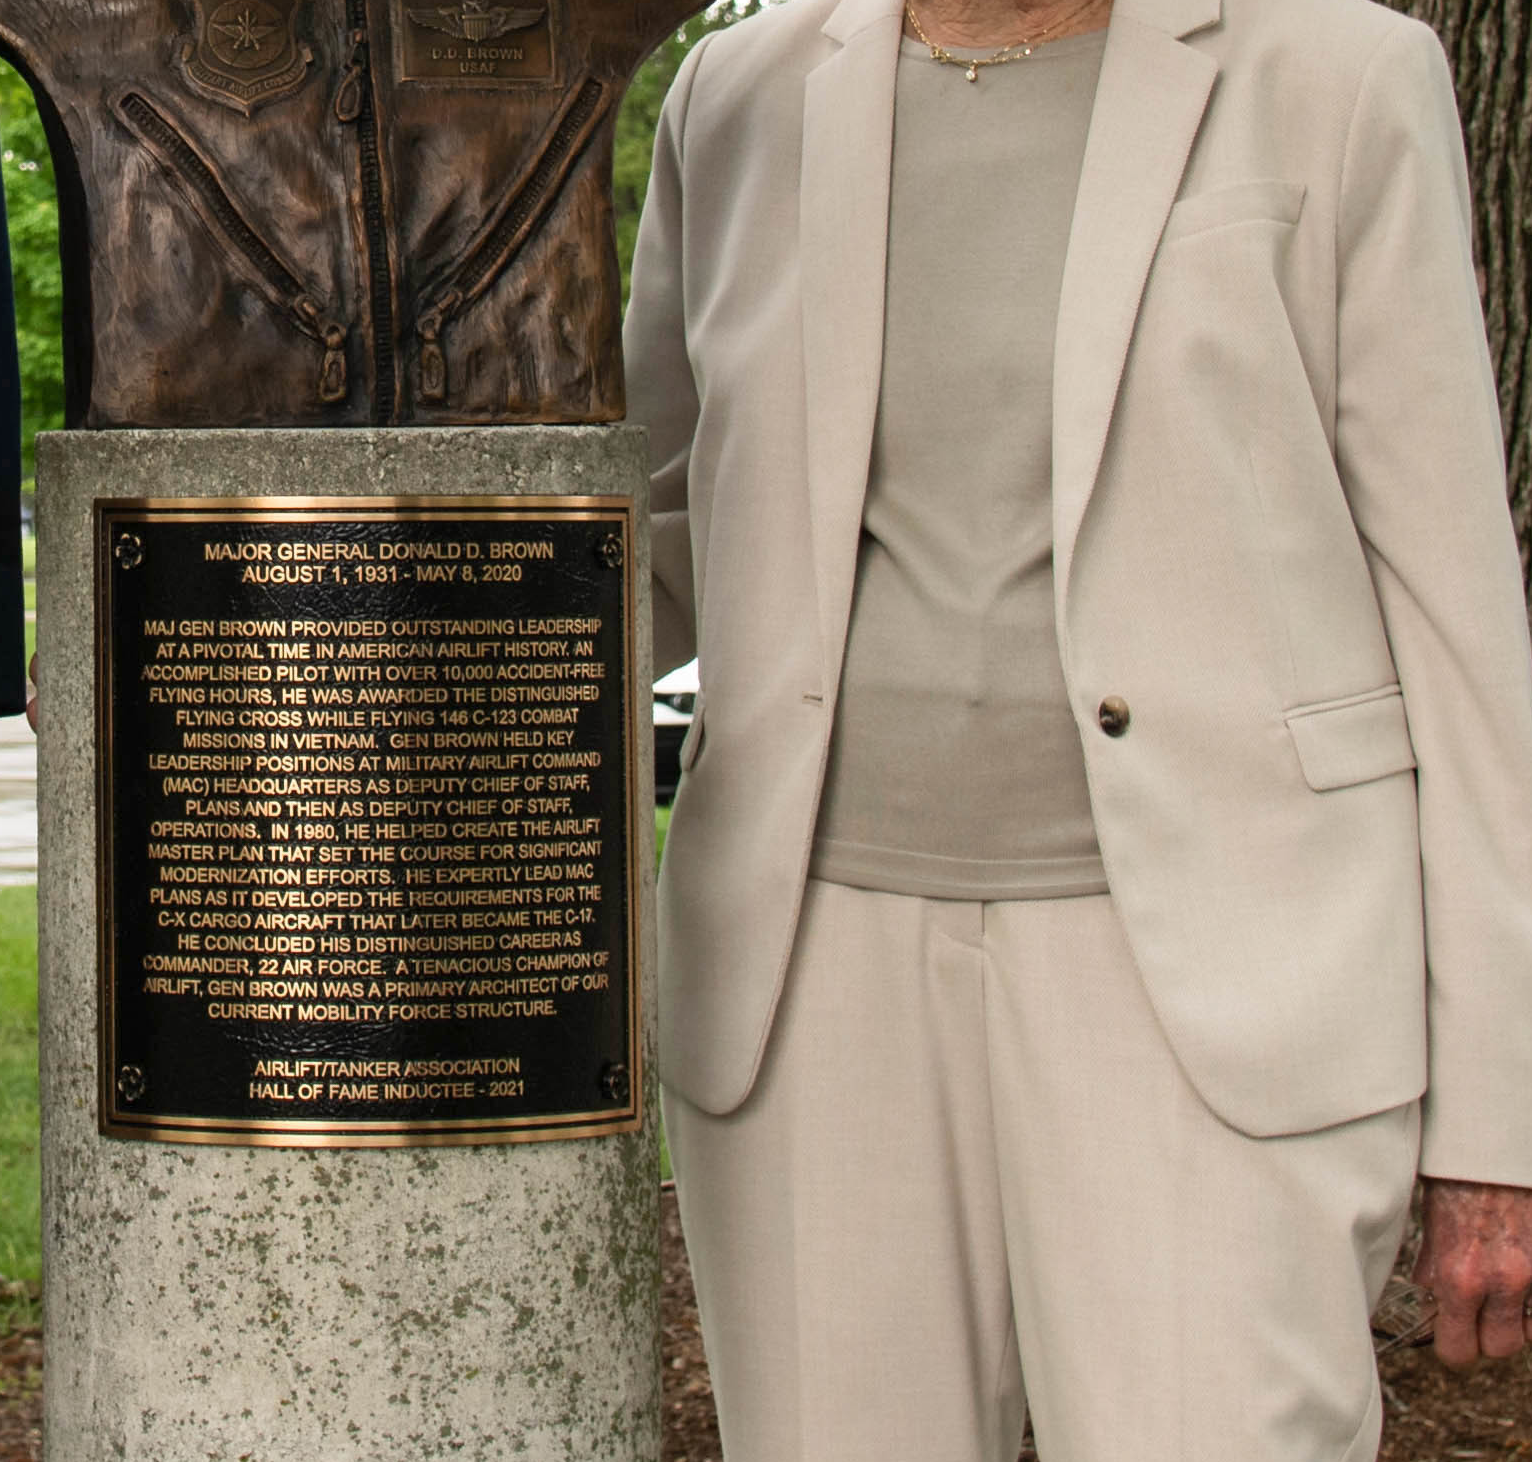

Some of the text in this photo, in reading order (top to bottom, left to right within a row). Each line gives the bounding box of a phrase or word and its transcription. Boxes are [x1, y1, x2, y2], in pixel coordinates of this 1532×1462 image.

[432, 47, 523, 60] D.D. BROWN
[460, 61, 497, 74] USAF
[205, 542, 554, 560] MAJOR GENERAL DONALD D. BROWN
[242, 565, 522, 585] AUGUST 1, 1931 MAY 8, 2020
[144, 618, 602, 637] MAJ GEN BROWN PROVIDED OUTSTANDING LEADERSHIP
[156, 640, 593, 660] AT A PIVOTAL TIME IN AMERICAN AIRLIFT HISTORY. AN
[141, 662, 606, 682] ACCOMPLISHED PILOT WITH OVER 10,000 ACCIDENT-FREE
[149, 685, 599, 707] FLYING HOURS, HE WAS AWARDED THE DISTINGUISHED
[176, 707, 579, 727] FLYING CROSS WHILE FLYING 146 C-123 COMBAT
[183, 730, 574, 749] MISSIONS IN VIETNAM. GEN BROWN HELD KEY
[149, 751, 601, 772] LEADERSHIP POSITIONS AT MILITARY AIRLIFT COMMAND
[163, 775, 590, 796] (MAC) HEADQUARTERS AS DEPUTY CHIEF OF STAFF,
[186, 798, 573, 817] PLANS AND THEN AS DEPUTY CHIEF OF STAFF,
[151, 818, 601, 842] OPERATIONS. IN 1980, HE HELPED CREATE THE AIRLIFT
[148, 840, 602, 862] MASTER PLAN THAT SET THE COURSE FOR SIGNIFICANT
[160, 863, 594, 885] MODERNIZATION EFFORTS. HE EXPERTLY LEAD MAC
[150, 885, 601, 908] PLANS AS IT DEVELOPED THE REQUIREMENTS FOR THE
[158, 908, 595, 930] C-X CARGO AIRCRAFT THAT LATER BECAME THE C-17.
[178, 931, 581, 953] HE CONCLUDED HIS DISTINGUISHED CAREER AS
[143, 951, 590, 976] COMMANDER, 22 AIR FORCE. A TENACIOUS CHAMPION
[143, 976, 558, 998] AIRLIFT, GEN BROWN WAS A PRIMARY ARCHITECT
[208, 1000, 557, 1021] CURRENT MOBILITY FORCE STRUCTURE.
[254, 1059, 520, 1078] AIRLIFT/TANKER ASSOCIATION
[249, 1081, 524, 1100] HALL OF FAME INDUCTEE 2021
